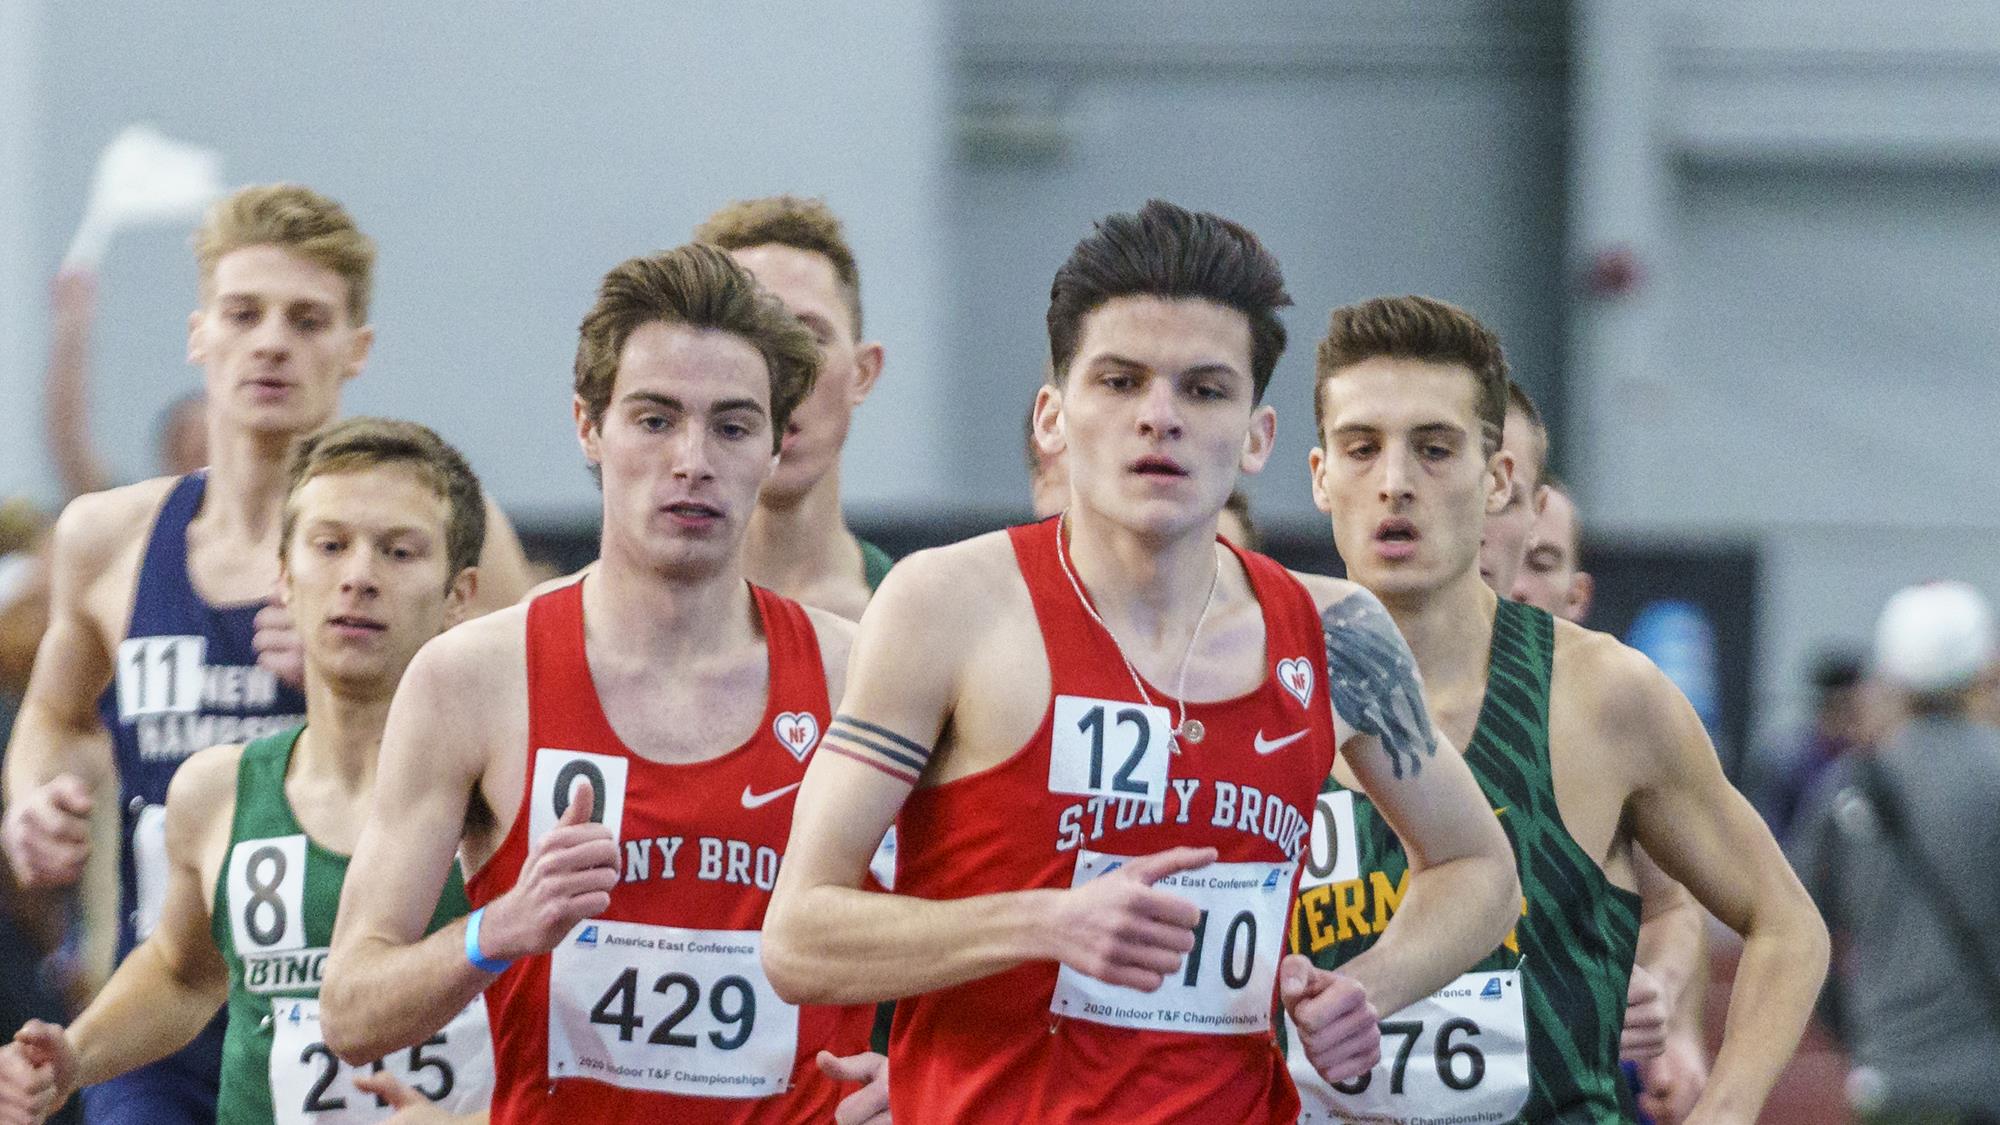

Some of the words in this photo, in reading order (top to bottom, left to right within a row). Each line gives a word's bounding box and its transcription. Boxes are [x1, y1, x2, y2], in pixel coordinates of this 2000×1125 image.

[132, 641, 178, 708] 11
[202, 664, 276, 706] NEW
[1290, 673, 1305, 690] NF
[789, 727, 806, 743] NF
[1077, 705, 1150, 794] 12
[1055, 778, 1200, 851] STONY
[1211, 780, 1310, 868] BROOK
[616, 837, 683, 882] NY
[698, 836, 784, 892] BRO
[1181, 876, 1205, 888] East
[1209, 878, 1259, 889] Conference
[244, 846, 287, 946] 8
[605, 934, 654, 949] America
[658, 939, 684, 953] East
[687, 941, 755, 955] Conference
[590, 967, 757, 1051] 429
[1083, 1002, 1112, 1017] 2020
[1115, 1006, 1152, 1021] Indoor
[1157, 1009, 1180, 1022] T&F
[579, 1055, 604, 1070] 2020
[606, 1061, 643, 1078] Indoor
[648, 1066, 671, 1081] T&F
[674, 1069, 767, 1086] Championships
[1330, 1016, 1487, 1096] 76
[1410, 1111, 1503, 1125] Championships
